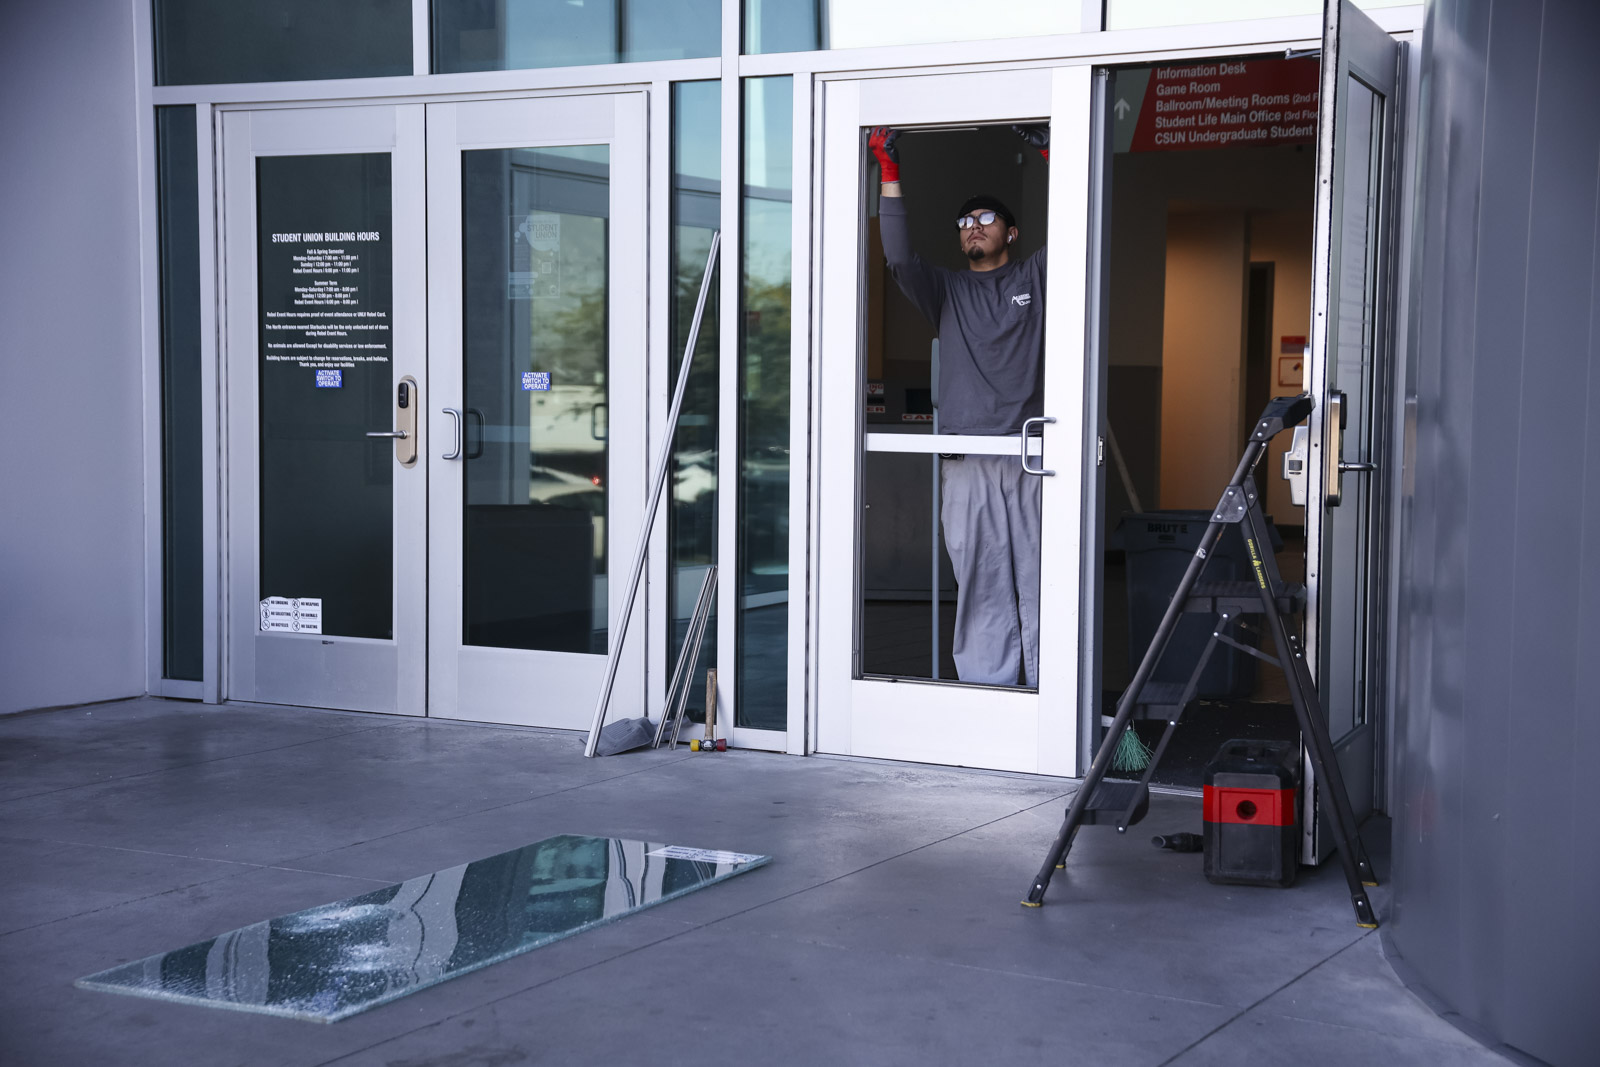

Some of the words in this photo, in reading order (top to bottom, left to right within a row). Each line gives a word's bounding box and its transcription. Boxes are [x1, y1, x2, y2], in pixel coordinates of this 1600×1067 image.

[1157, 65, 1216, 80] Information
[1219, 62, 1246, 75] Desk
[1156, 84, 1186, 96] Game
[1190, 82, 1220, 93] Room
[1156, 95, 1248, 112] Ballroom/Meeting
[1252, 94, 1290, 105] Rooms
[1292, 92, 1311, 104] (2nd
[1156, 116, 1196, 128] Student
[1198, 114, 1218, 126] Life
[1220, 112, 1246, 124] Main
[1250, 110, 1281, 122] Office
[1284, 110, 1300, 122] (3rd
[1155, 132, 1186, 144] CSUN
[1189, 127, 1268, 144] Undergraduate
[1270, 124, 1314, 138] Student
[272, 233, 301, 242] STUDENT
[302, 232, 323, 242] UNION
[324, 232, 355, 242] BUILDING
[356, 232, 380, 241] HOURS
[1147, 523, 1188, 533] BRUTE
